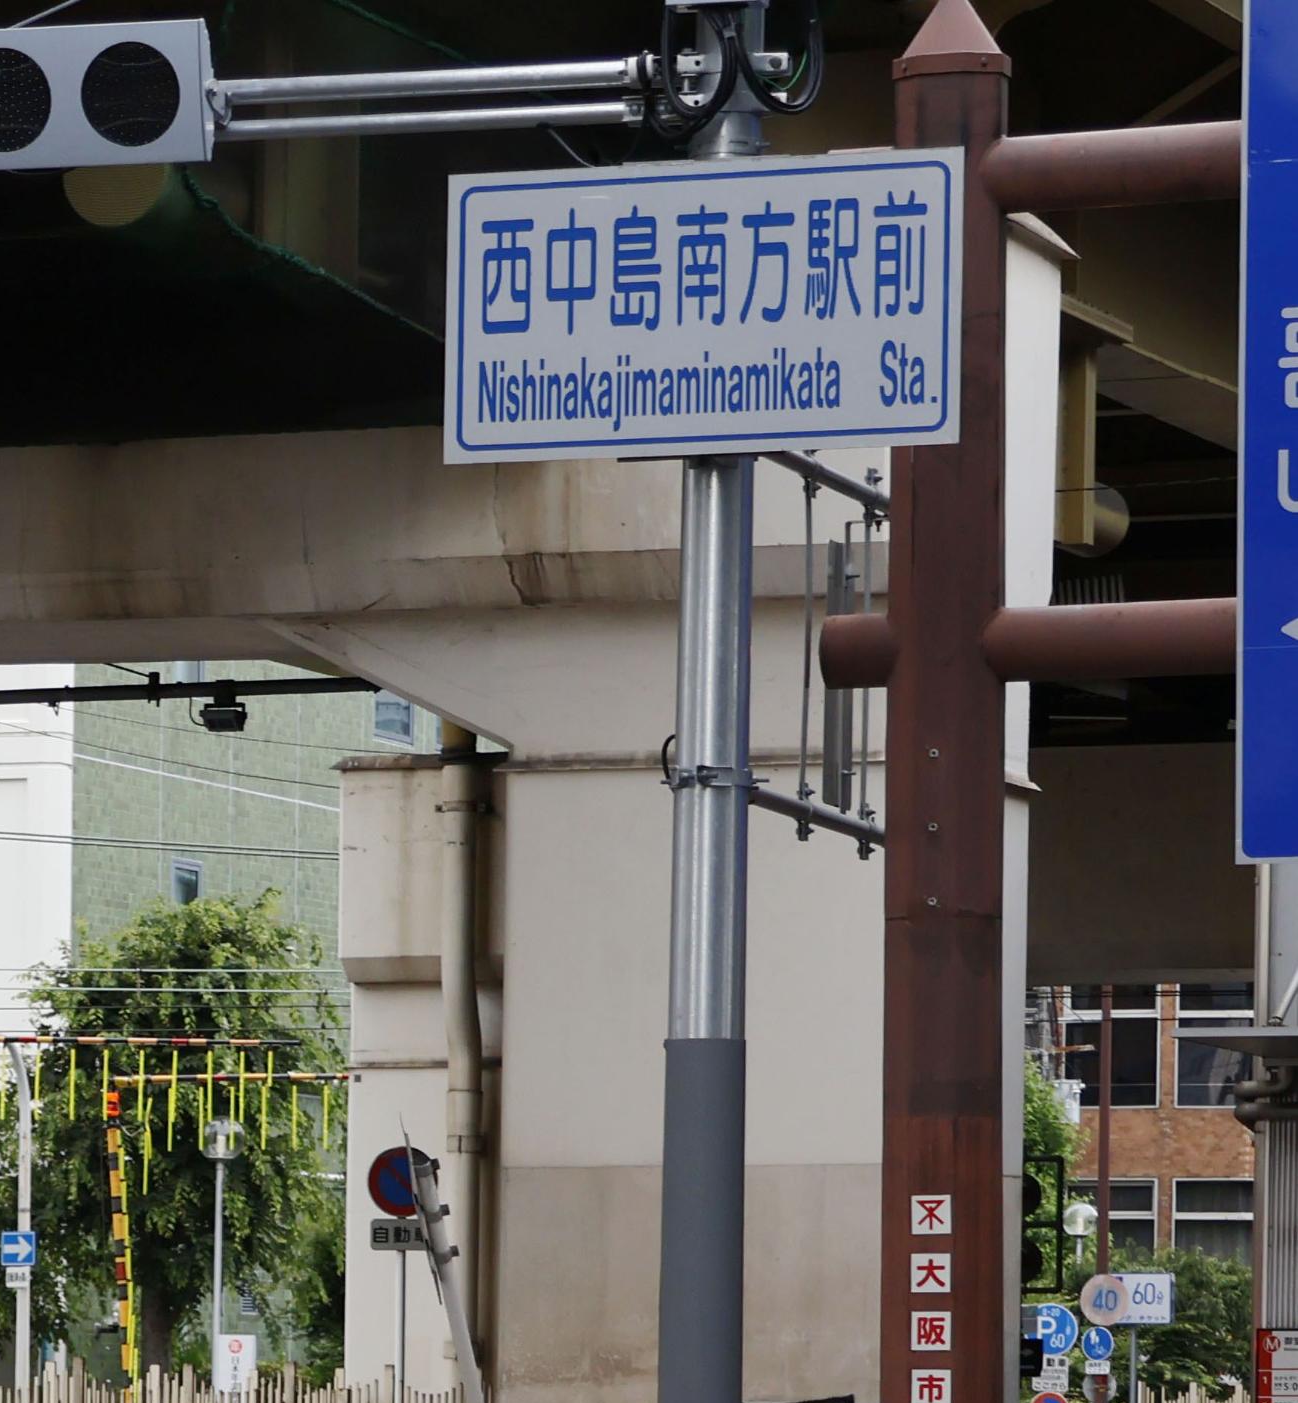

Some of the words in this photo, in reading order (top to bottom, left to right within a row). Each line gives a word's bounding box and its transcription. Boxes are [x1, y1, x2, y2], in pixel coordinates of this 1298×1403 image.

[481, 189, 929, 336] 西中島南方駅前
[477, 346, 841, 432] Nishinakajimaminamikata
[879, 340, 939, 408] Sta.
[1037, 1316, 1057, 1340] P
[1092, 1289, 1118, 1311] 40
[916, 1259, 946, 1403] 大阪市
[1050, 1333, 1066, 1349] 60
